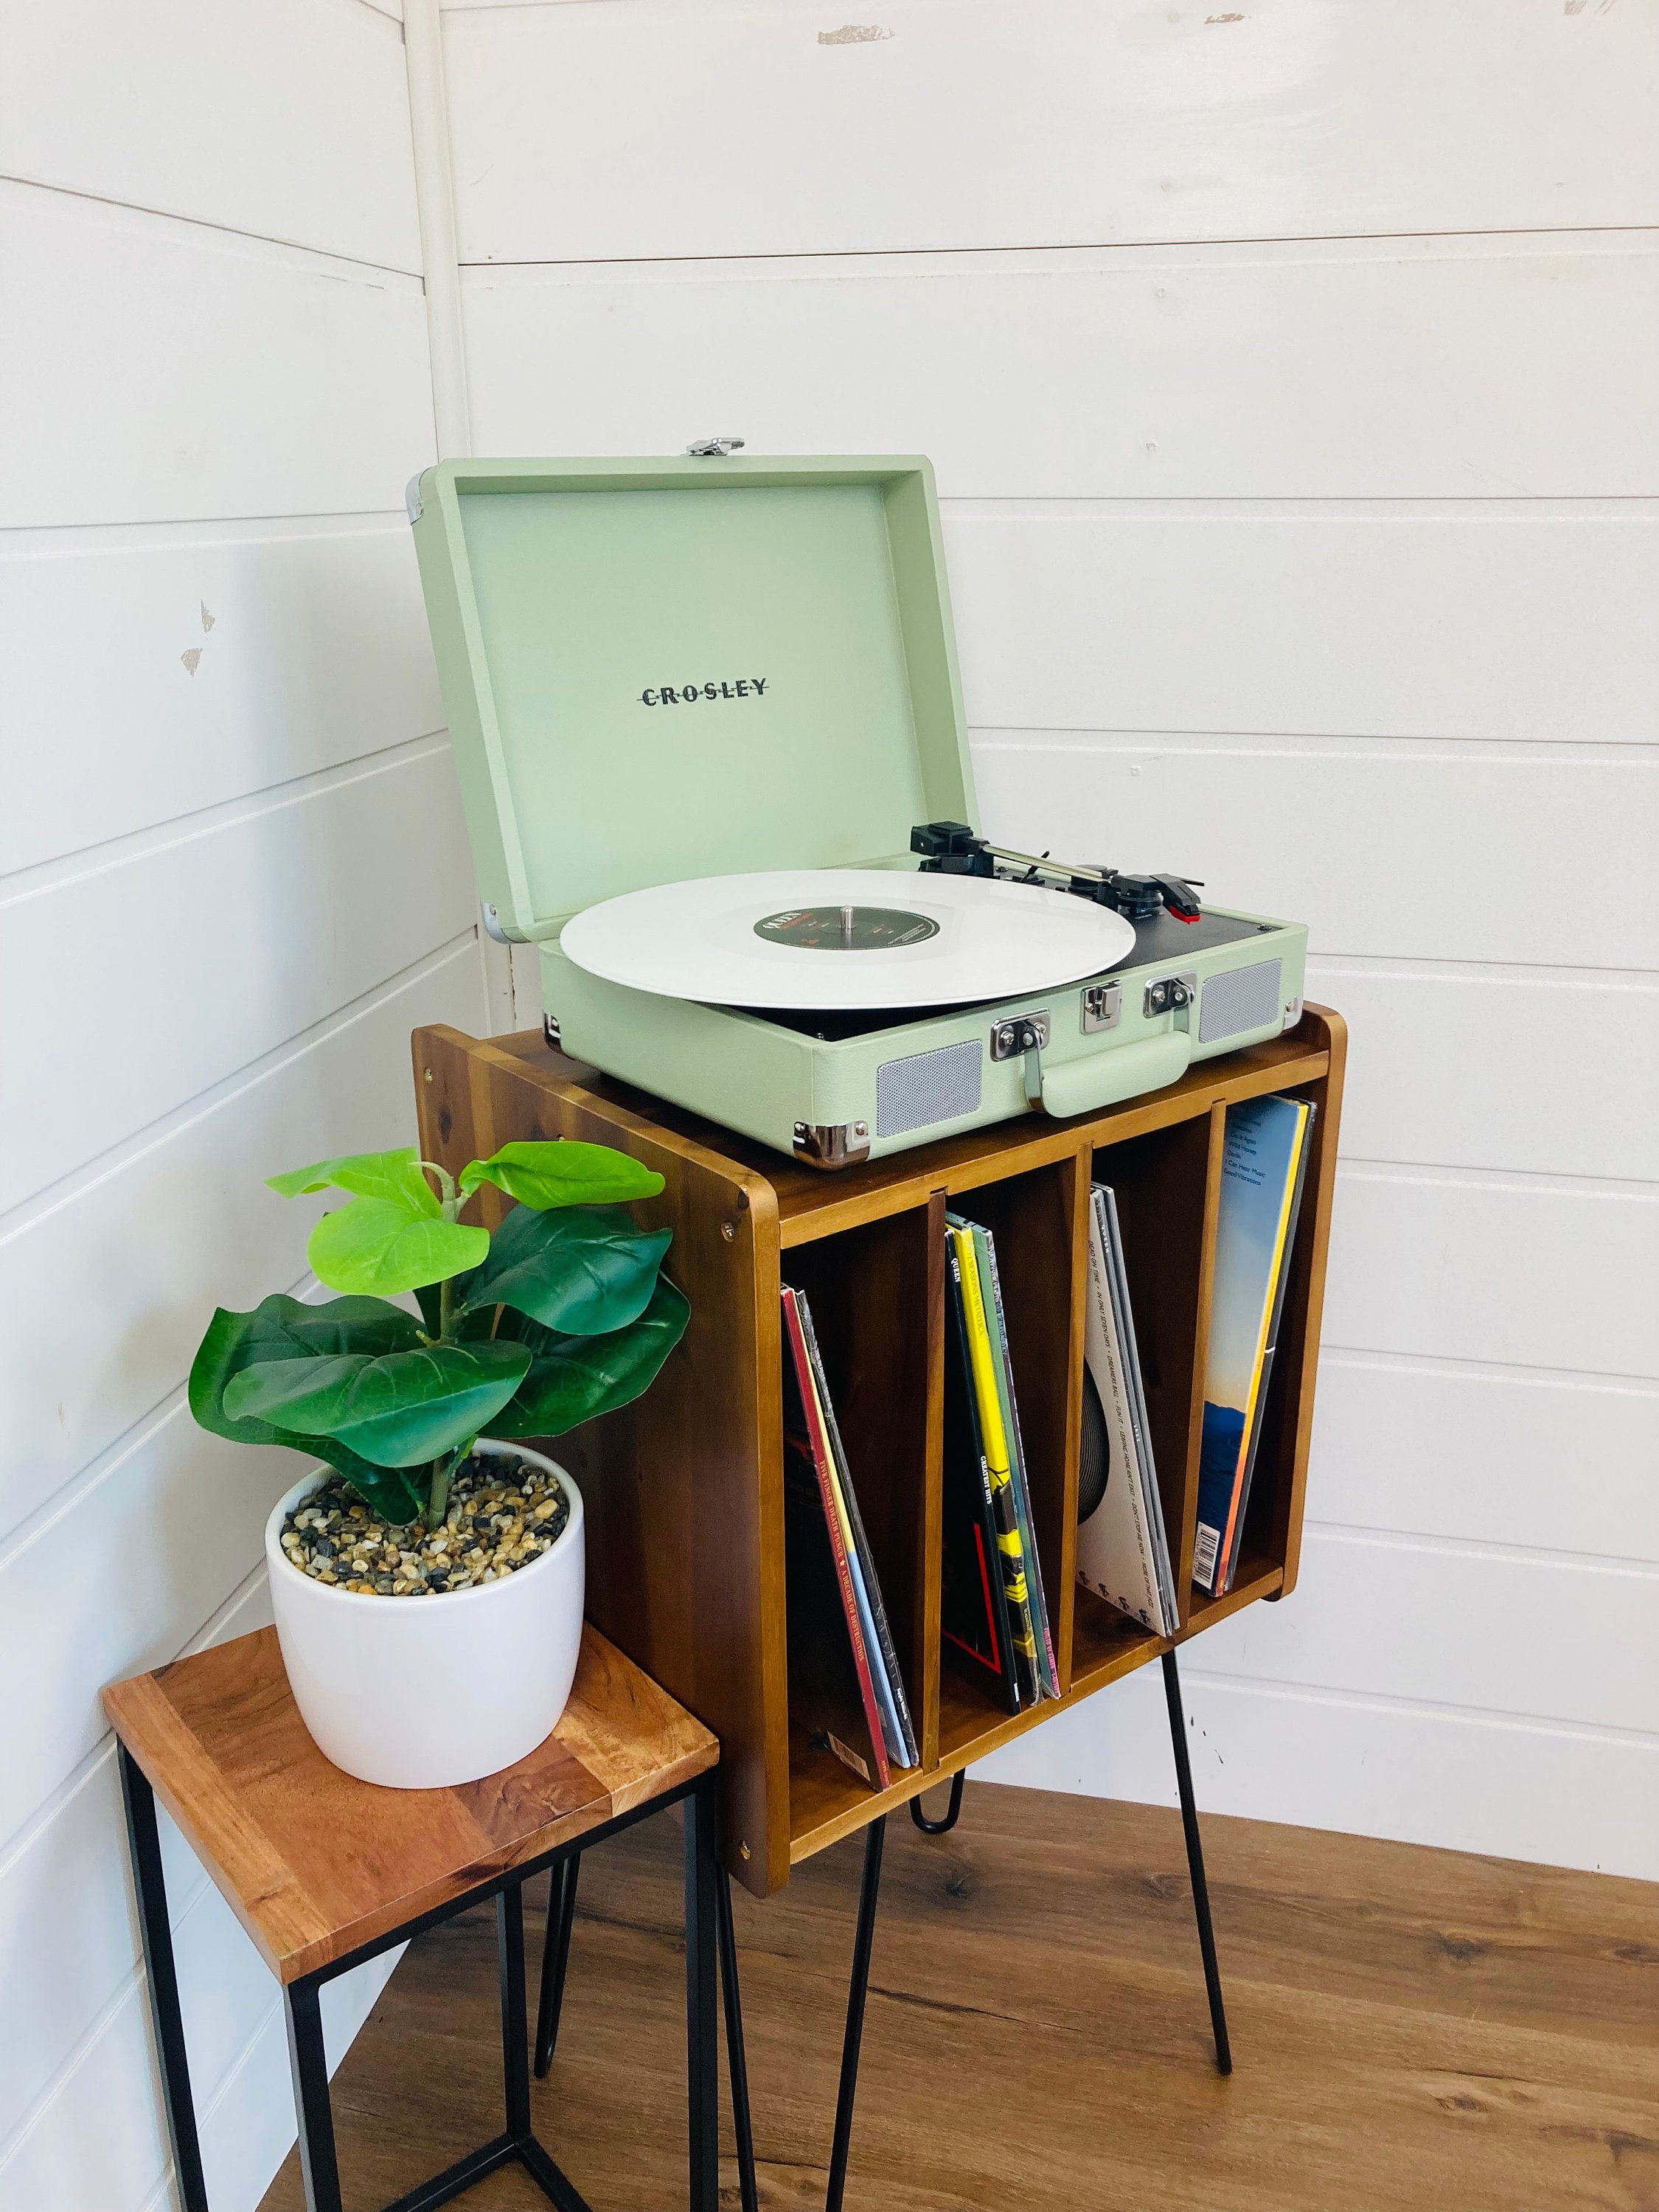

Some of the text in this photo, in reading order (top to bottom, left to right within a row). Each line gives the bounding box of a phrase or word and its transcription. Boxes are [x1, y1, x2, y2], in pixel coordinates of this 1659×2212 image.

[639, 678, 767, 706] CROSLEY
[1223, 1168, 1237, 1178] Good
[1251, 1168, 1266, 1178] Music
[1101, 1224, 1110, 1253] QUEEN
[951, 1257, 961, 1282] QUEEN
[1091, 1257, 1097, 1268] ON
[1096, 1291, 1102, 1299] IN
[967, 1259, 978, 1295] SEASONS
[973, 1295, 985, 1336] METALLICA
[819, 1460, 829, 1478] FIVE
[981, 1455, 992, 1505] GREATEST HITS
[823, 1478, 834, 1506] FINGER
[829, 1506, 839, 1532] DEATH
[834, 1531, 844, 1558] PUNCH
[843, 1575, 853, 1604] DECADE
[848, 1605, 856, 1614] OF
[850, 1613, 865, 1662] DESTRUCTION
